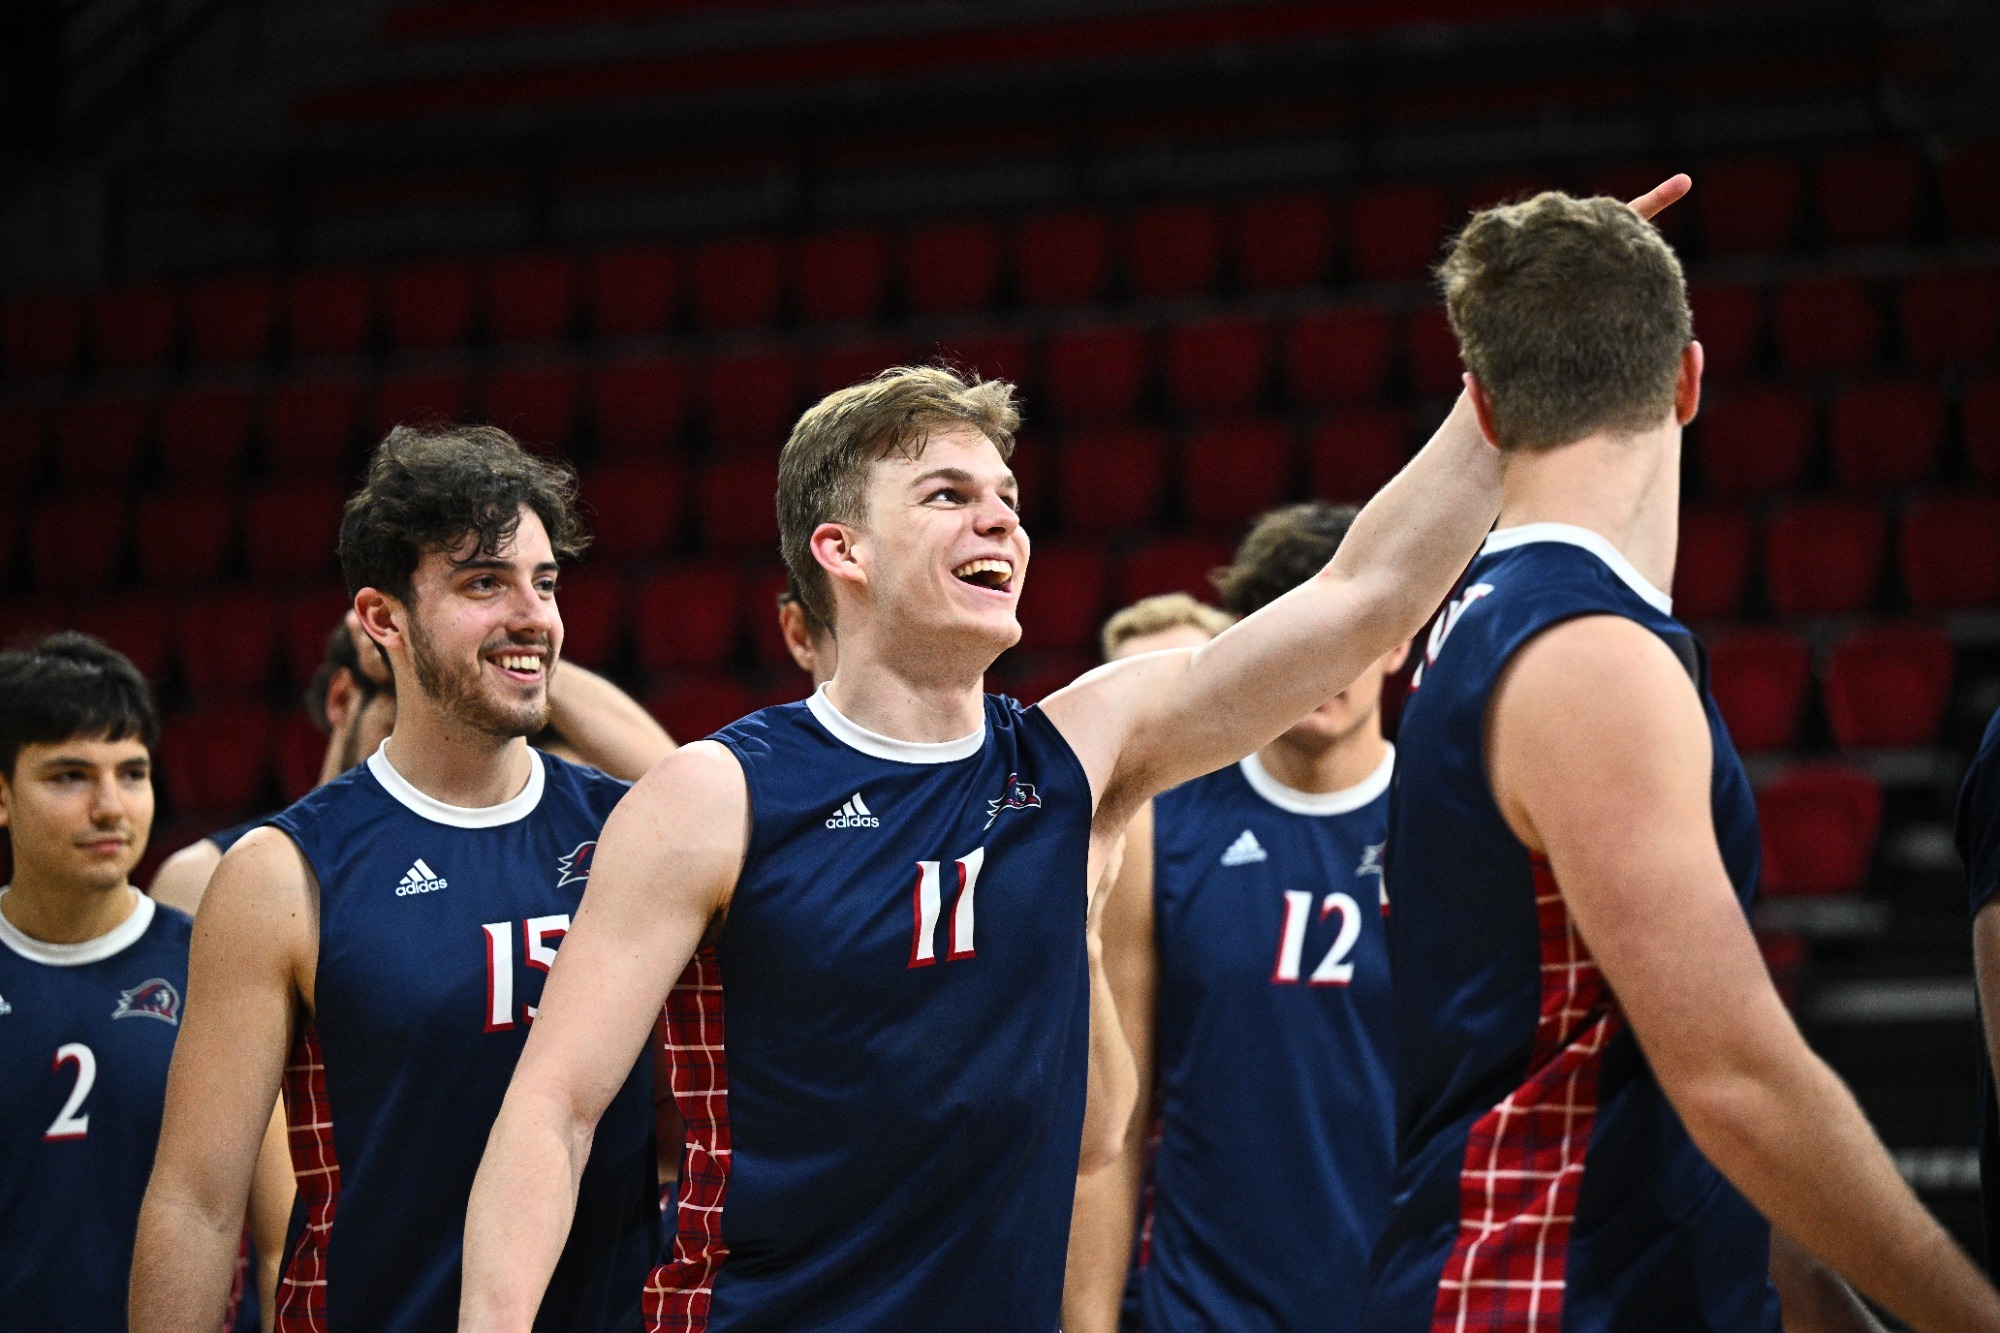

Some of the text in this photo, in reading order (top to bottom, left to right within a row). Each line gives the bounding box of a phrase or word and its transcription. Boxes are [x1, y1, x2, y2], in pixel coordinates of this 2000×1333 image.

[825, 815, 880, 829] adidas
[395, 878, 448, 896] adidas
[906, 846, 985, 969] 11
[1270, 889, 1362, 988] 12
[42, 1042, 97, 1144] 2
